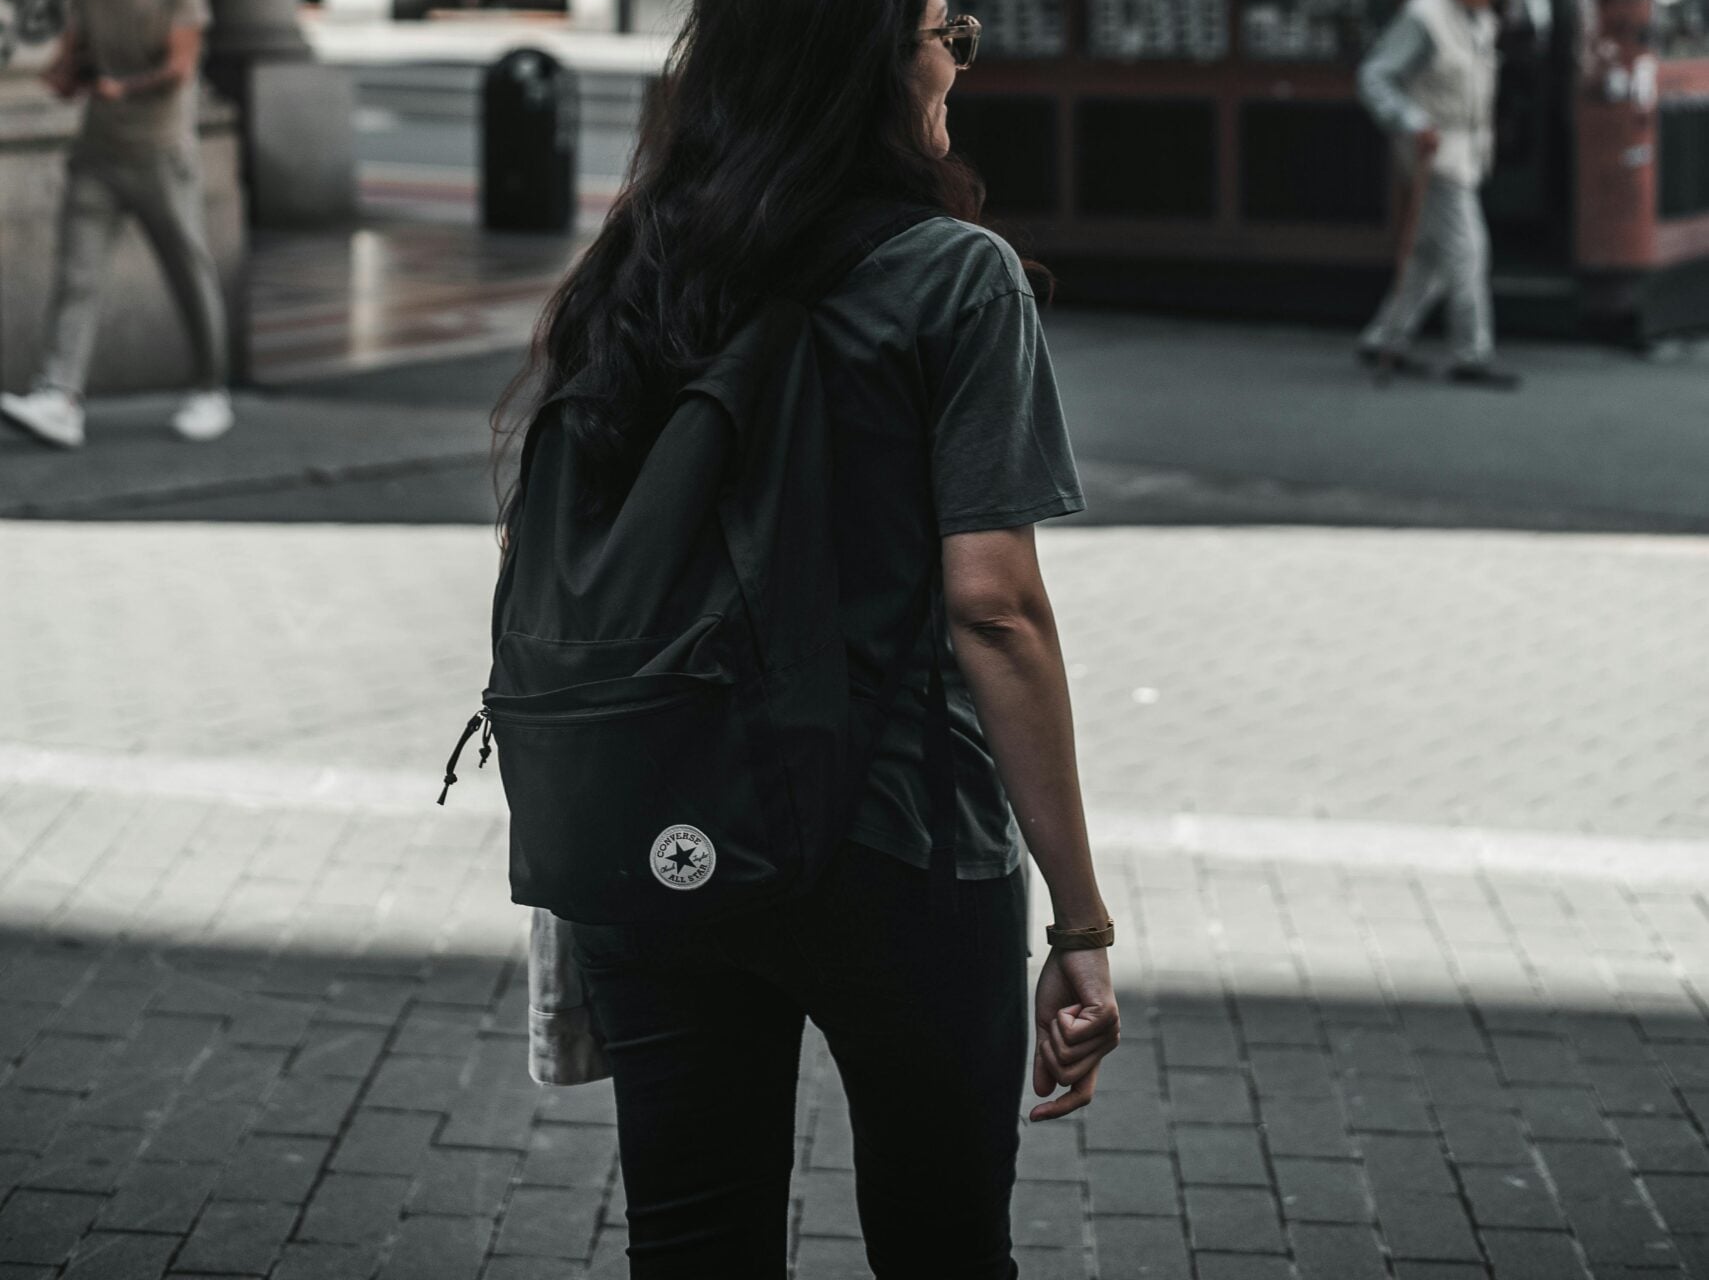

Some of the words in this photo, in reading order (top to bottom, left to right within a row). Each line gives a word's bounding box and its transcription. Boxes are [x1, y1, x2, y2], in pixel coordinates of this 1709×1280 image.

[657, 833, 701, 858] CONVERSE
[668, 874, 686, 882] ALL
[688, 864, 707, 881] STAR
